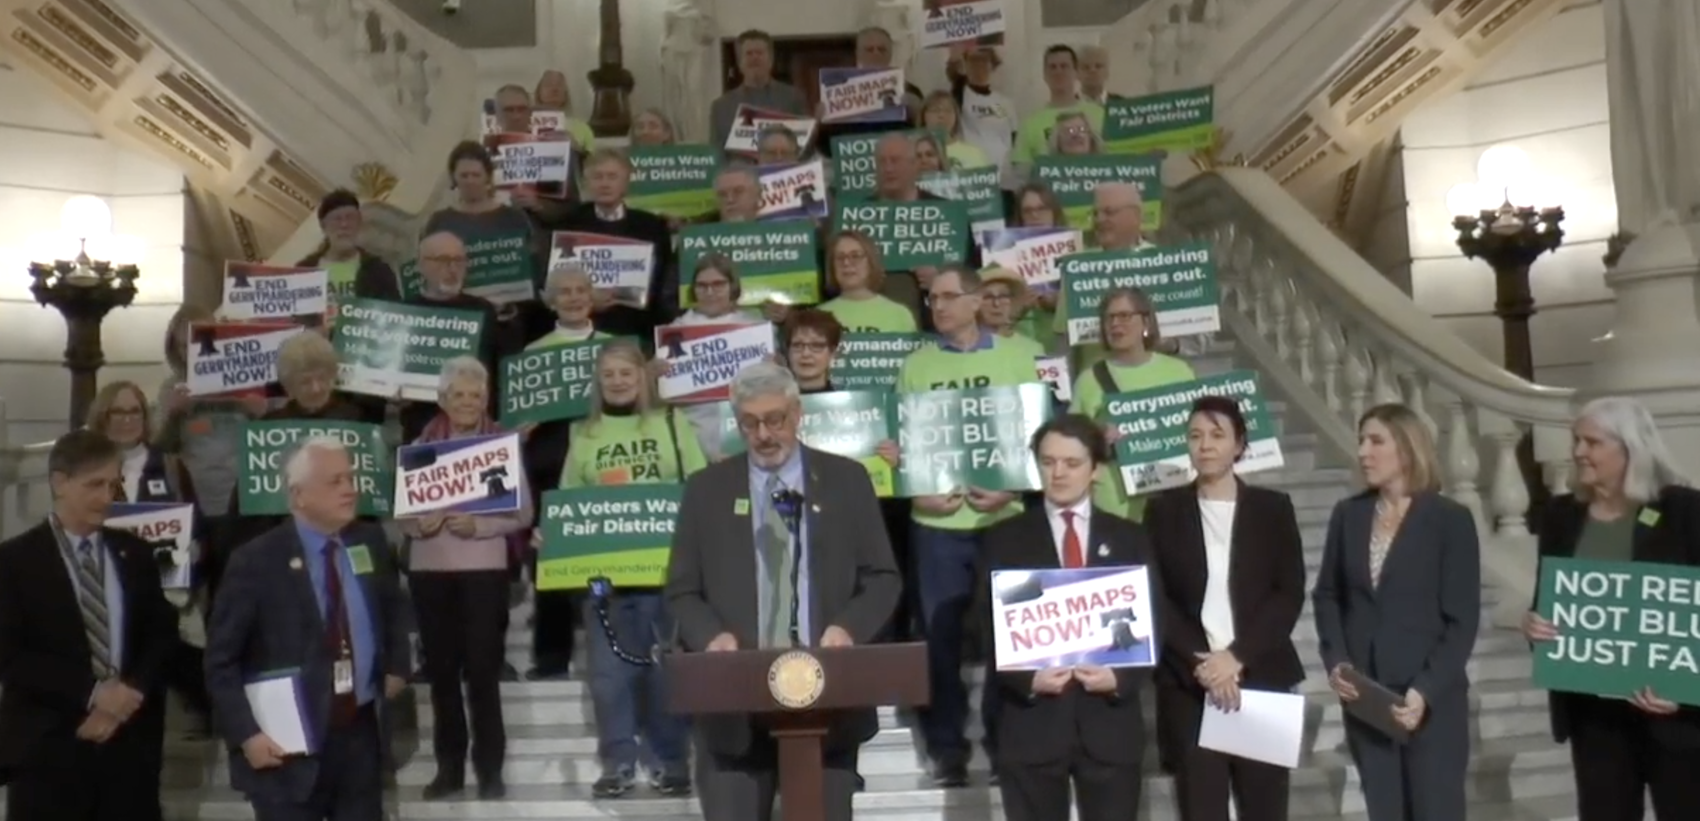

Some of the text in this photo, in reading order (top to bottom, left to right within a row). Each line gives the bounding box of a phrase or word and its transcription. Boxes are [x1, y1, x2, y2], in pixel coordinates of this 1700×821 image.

[826, 75, 898, 99] FAIR MAPS
[828, 93, 875, 113] NOW!
[1108, 94, 1210, 117] PA Voters Want
[1120, 108, 1200, 127] Fair Districts
[505, 146, 534, 158] END
[629, 154, 715, 168] Voters Want
[630, 167, 706, 181] air Districts
[772, 169, 816, 188] MAPS
[1040, 165, 1155, 178] PA Voters Want
[841, 174, 876, 190] JUS
[1053, 180, 1080, 192] Fair
[842, 206, 945, 221] NOT RED.
[894, 221, 956, 238] BLUE.
[683, 233, 809, 249] PA Voters Want
[898, 239, 952, 255] FAIR.
[1030, 239, 1076, 258] MAPS
[581, 248, 612, 260] END
[732, 248, 799, 262] Districts
[1066, 248, 1209, 275] Gerrymandering
[255, 278, 287, 291] END
[589, 272, 620, 284] OW!
[1072, 266, 1207, 293] cuts voters out.
[229, 286, 322, 303] GERRYMANDERING
[253, 300, 297, 314] NOW!
[341, 304, 479, 334] Gerrymandering
[223, 339, 260, 357] END
[440, 337, 471, 350] out.
[691, 338, 728, 357] END
[194, 350, 278, 376] GERRYMANDER
[507, 351, 554, 376] NOT
[222, 365, 271, 386] NOW!
[508, 369, 555, 394] NOT
[507, 387, 562, 413] JUST
[1117, 415, 1157, 435] cuts
[1161, 410, 1190, 428] vot
[247, 428, 302, 448] NOT
[898, 425, 955, 447] NOT
[1128, 434, 1187, 454] Make you
[596, 438, 659, 461] FAIR
[404, 446, 510, 488] FAIR MAPS
[595, 454, 662, 471] DISTRICTS
[631, 463, 661, 481] PA
[407, 475, 475, 506] NOW!
[547, 499, 681, 519] PA Voters Wa
[562, 516, 675, 537] Fair District
[544, 563, 665, 579] End Gerrymanderin
[1555, 569, 1700, 606] NOT RE
[1004, 584, 1137, 628] FAIR MAPS
[1553, 602, 1629, 632] NOT
[1010, 613, 1094, 653] NOW!
[1547, 635, 1699, 674] JUST FA
